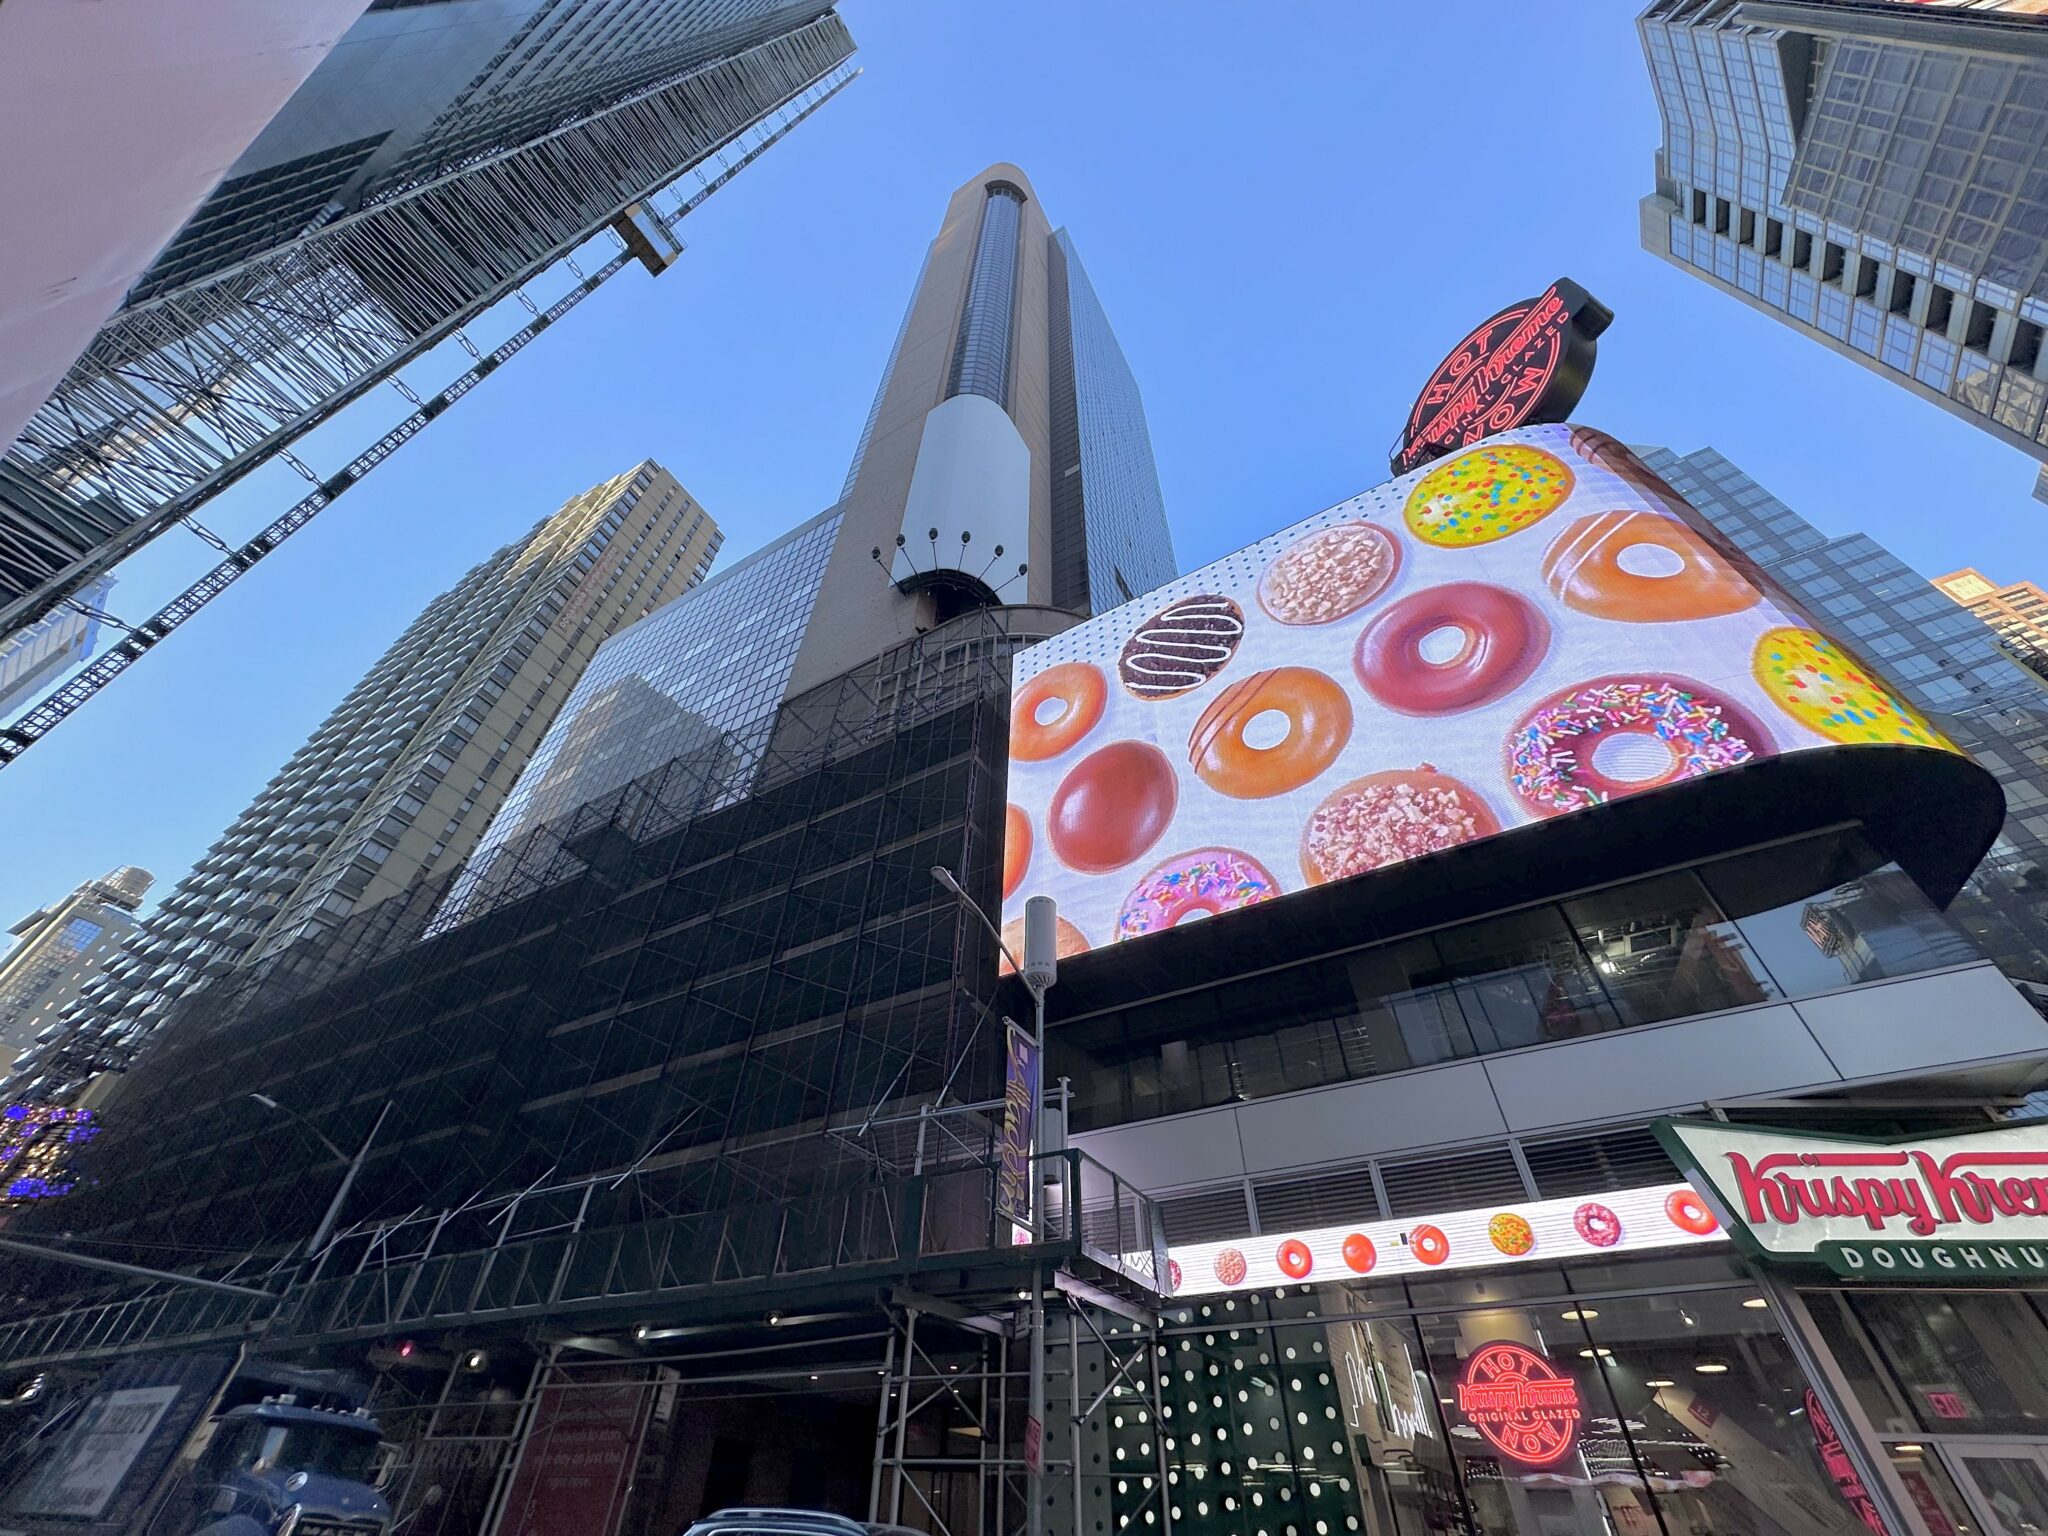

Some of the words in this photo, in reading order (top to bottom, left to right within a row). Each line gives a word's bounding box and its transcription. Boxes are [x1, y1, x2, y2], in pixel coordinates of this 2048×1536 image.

[1426, 329, 1494, 404] HOT
[1474, 286, 1564, 393] Kreme
[1501, 311, 1570, 384] GLAZED
[1462, 366, 1546, 447] NOW
[1723, 1150, 1941, 1237] Krispy
[1840, 1246, 2048, 1269] DOUGHNU
[1480, 1352, 1533, 1379] HOT
[1457, 1383, 1518, 1413] Krispy
[1515, 1378, 1578, 1409] Kreme
[1468, 1411, 1529, 1423] ORIGINAL
[1532, 1408, 1581, 1420] GLAZED
[1501, 1420, 1561, 1454] NOW
